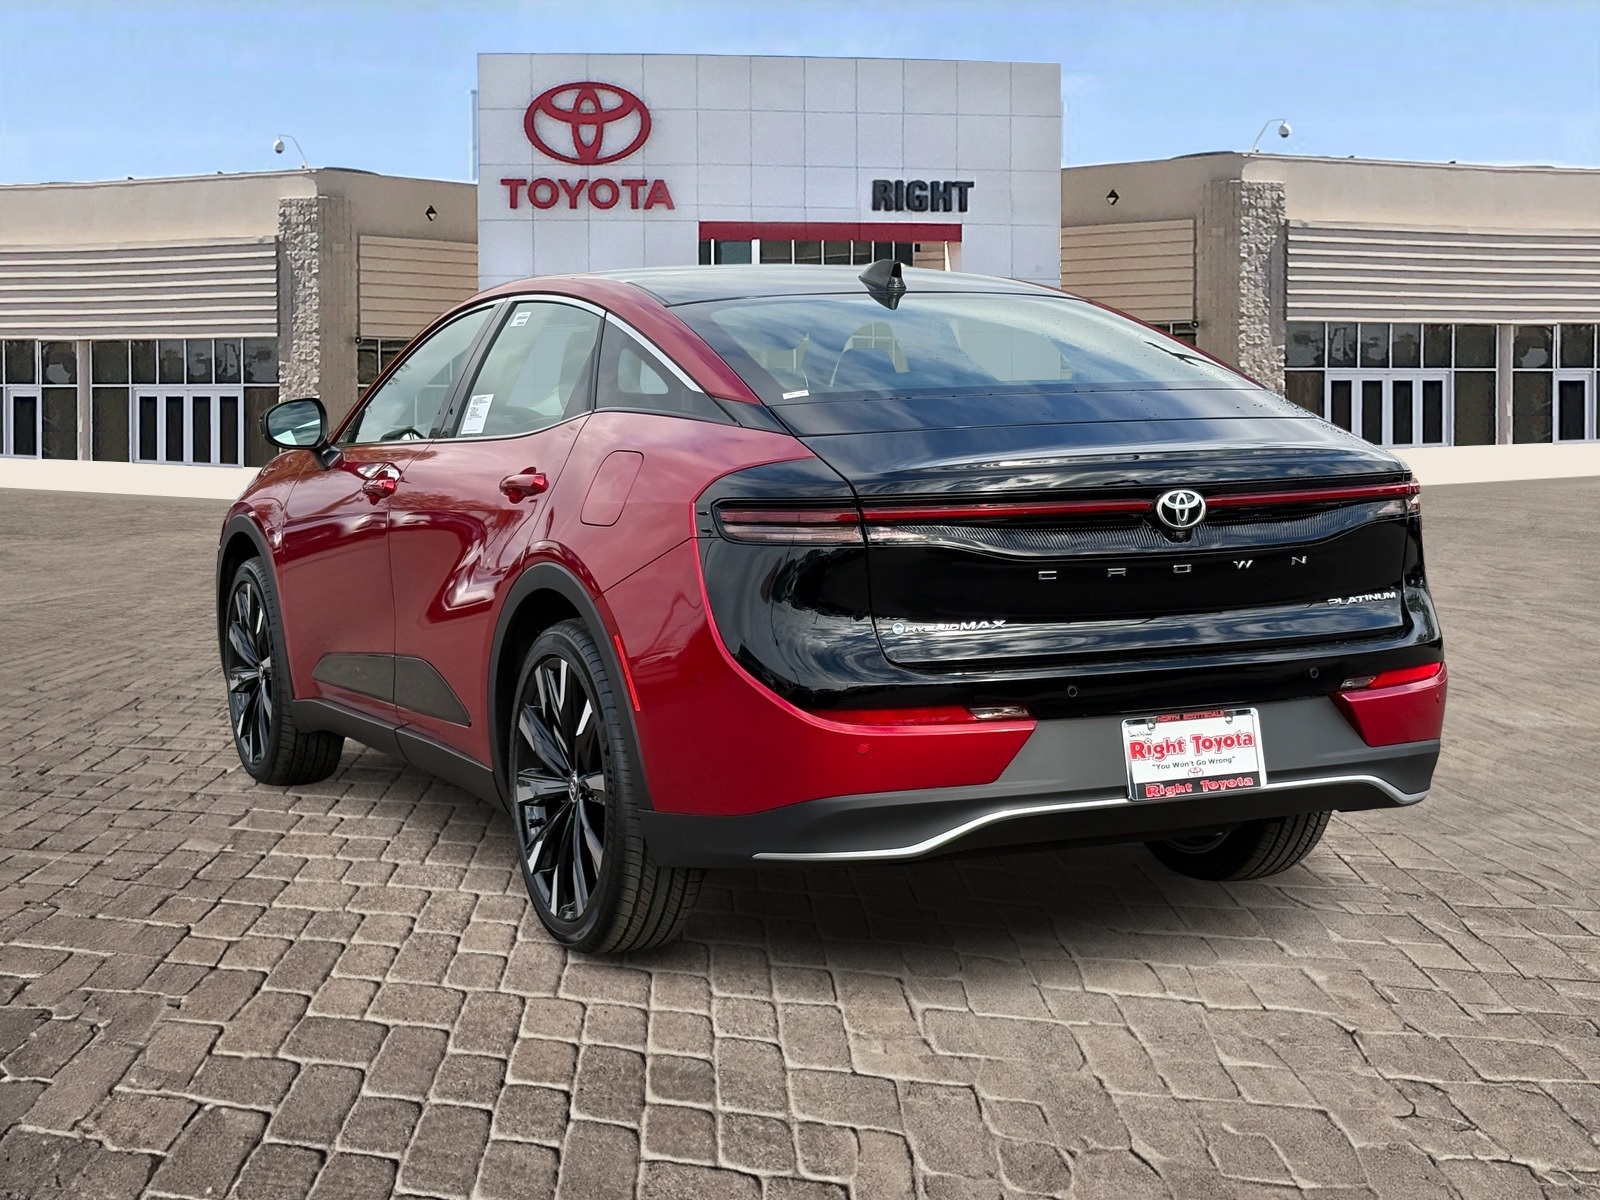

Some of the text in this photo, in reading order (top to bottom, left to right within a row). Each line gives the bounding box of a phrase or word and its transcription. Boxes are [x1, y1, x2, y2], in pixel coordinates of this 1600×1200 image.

[500, 178, 675, 211] TOYOTA
[872, 179, 975, 212] RIGHT
[1037, 554, 1308, 582] CROWN
[1327, 591, 1397, 605] PLATINUM
[1129, 731, 1255, 760] Right Toyota
[1152, 762, 1171, 770] "You
[1172, 759, 1195, 768] Won't
[1209, 755, 1236, 765] Wrong"
[1145, 776, 1254, 798] Right Toyota
